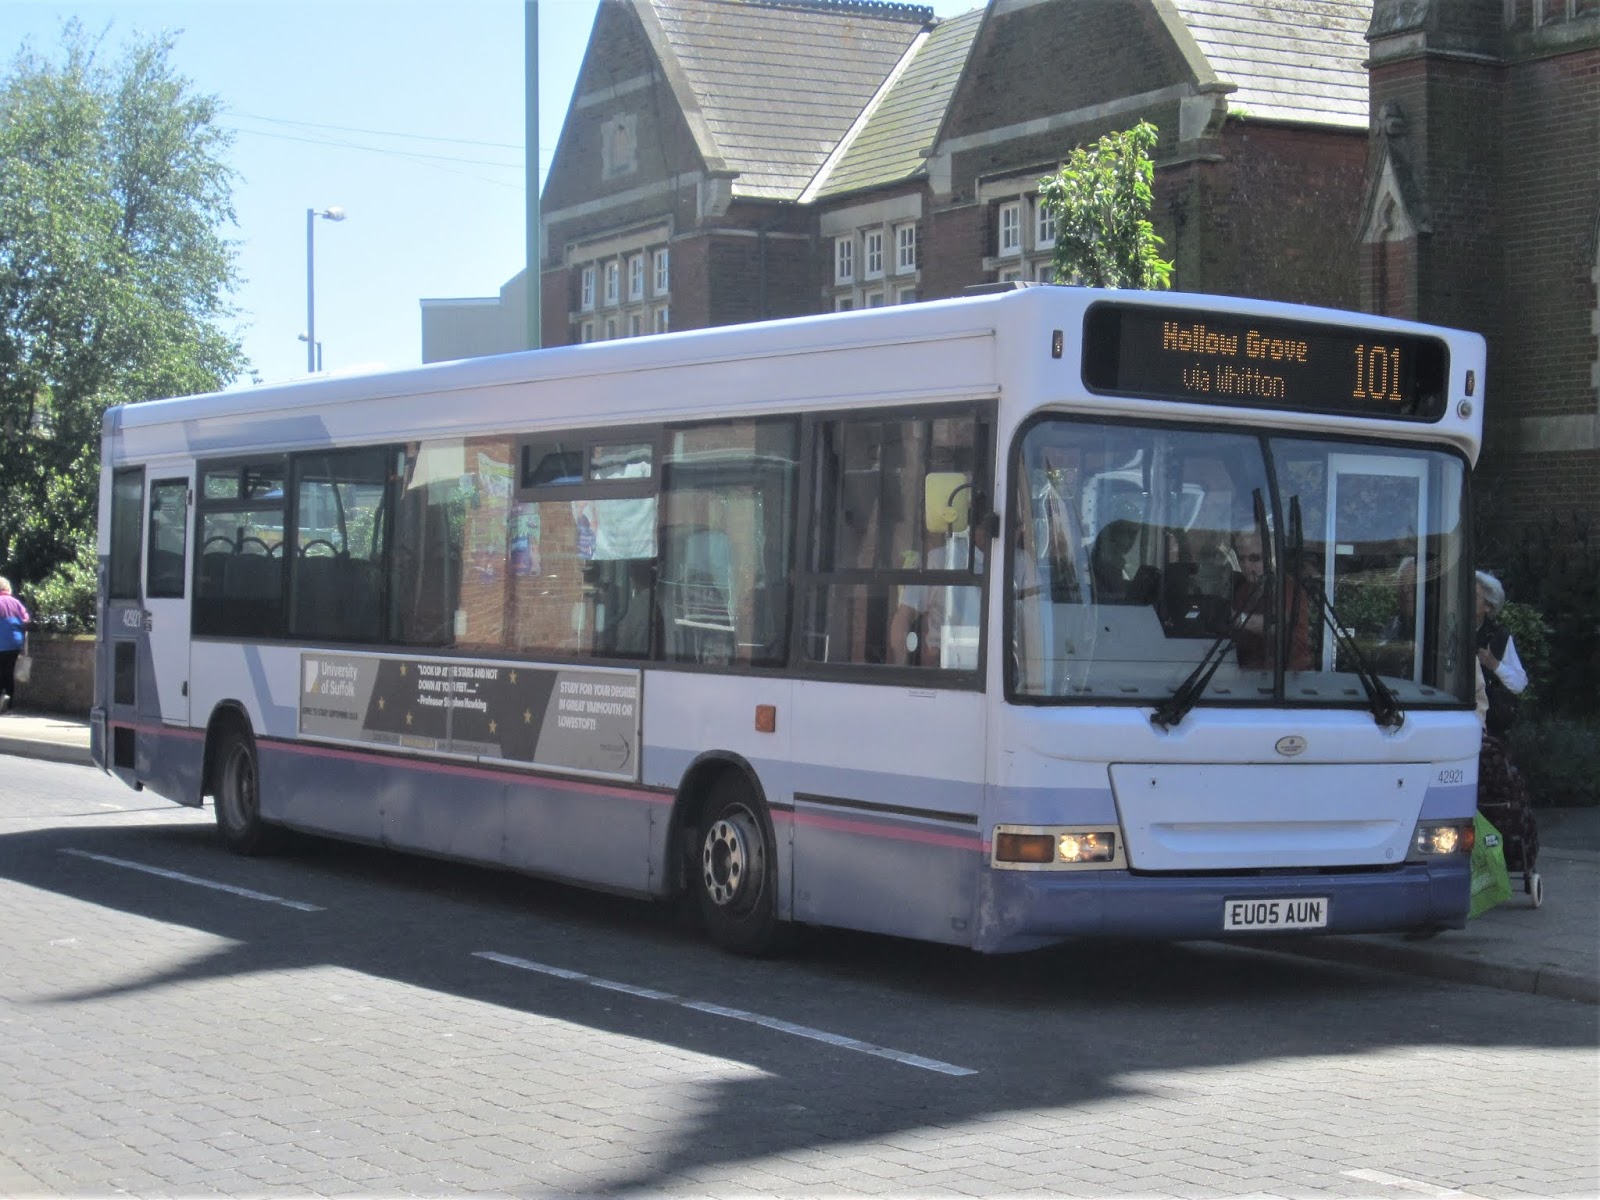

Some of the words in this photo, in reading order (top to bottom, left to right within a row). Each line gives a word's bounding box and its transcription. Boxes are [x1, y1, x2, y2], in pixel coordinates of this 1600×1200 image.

[1163, 321, 1238, 356] Hollow
[1246, 330, 1308, 362] Grove
[1183, 363, 1210, 392] via
[1216, 364, 1285, 398] Whitton
[1353, 344, 1401, 401] 101
[321, 661, 358, 681] University
[434, 665, 441, 677] UP
[441, 666, 448, 677] AT
[458, 666, 474, 679] STARS
[474, 668, 485, 679] AND
[485, 668, 498, 680] NOT
[320, 679, 329, 694] of
[330, 680, 355, 697] Suffolk
[418, 680, 435, 691] DOWN
[435, 681, 441, 692] AT
[441, 681, 456, 692] YOR
[560, 681, 579, 694] STUDY
[579, 683, 593, 695] FOR
[593, 684, 610, 697] YOUR
[610, 685, 636, 699] DEGREE
[559, 699, 566, 711] IN
[566, 699, 585, 712] GREAT
[586, 701, 621, 715] YARMOUTH
[621, 703, 633, 716] OR
[1438, 769, 1464, 784] 42921
[1232, 903, 1280, 925] EU05
[1285, 901, 1320, 923] AUN
